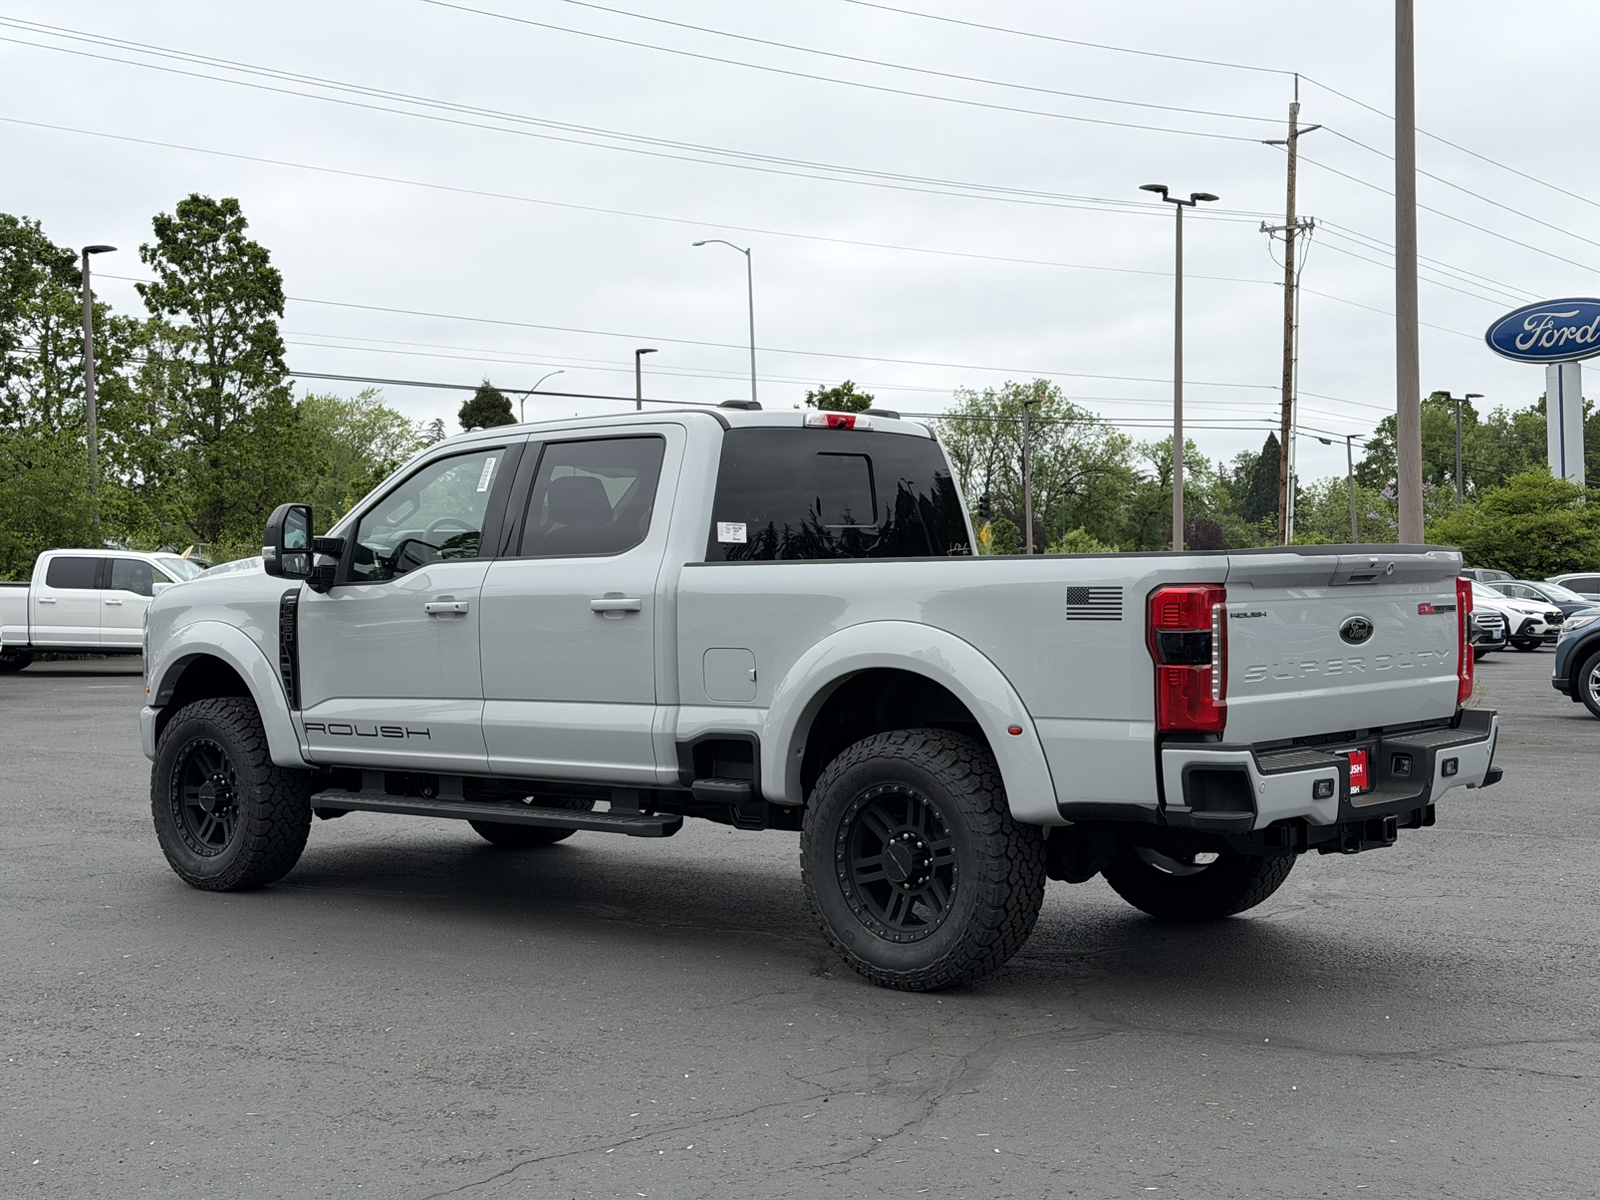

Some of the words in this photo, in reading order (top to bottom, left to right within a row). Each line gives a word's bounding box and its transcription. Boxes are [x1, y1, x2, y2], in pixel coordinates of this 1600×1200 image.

[1515, 309, 1600, 351] Ford
[1243, 656, 1366, 683] SUPER
[1374, 648, 1450, 672] DUTY
[304, 722, 431, 740] ROUSH
